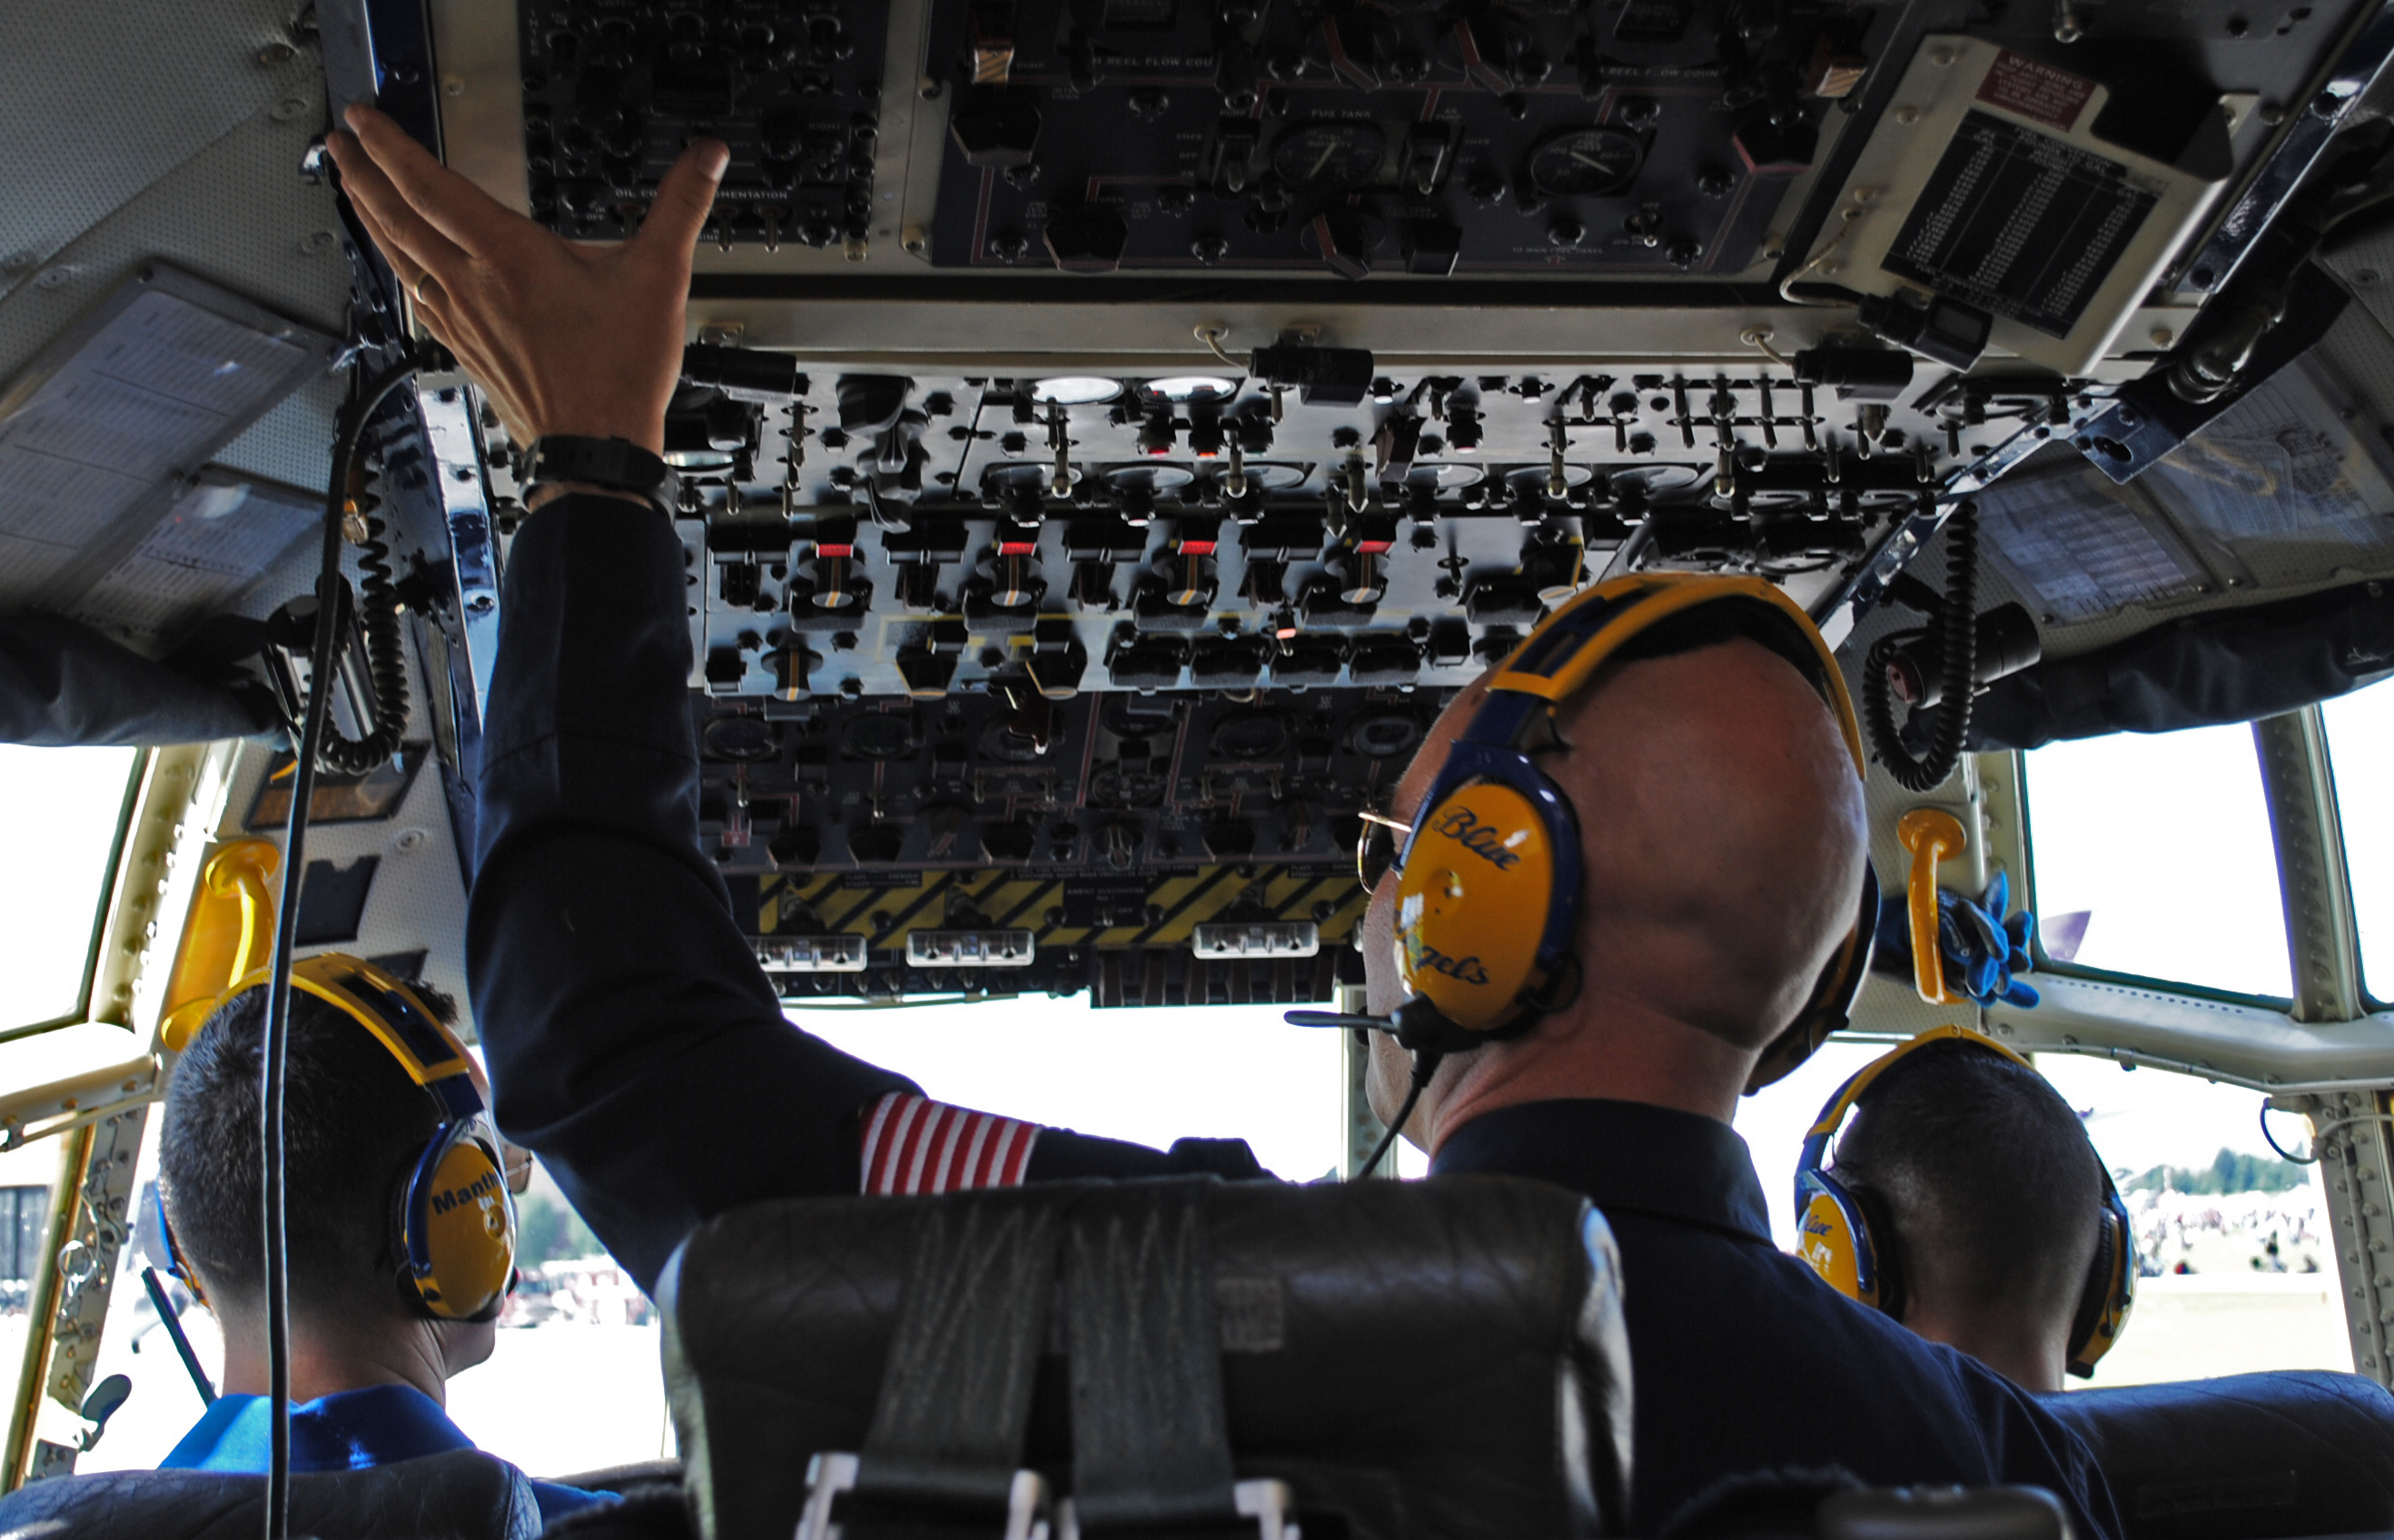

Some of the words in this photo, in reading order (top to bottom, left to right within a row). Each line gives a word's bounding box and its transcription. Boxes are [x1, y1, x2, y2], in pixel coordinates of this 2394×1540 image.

[1106, 56, 1140, 66] REEL
[1145, 56, 1181, 67] FLOW
[1607, 67, 1639, 77] REEL
[2009, 55, 2083, 90] WARNING
[1340, 109, 1372, 119] TANK
[615, 189, 637, 199] OIL
[1432, 805, 1521, 872] Blue
